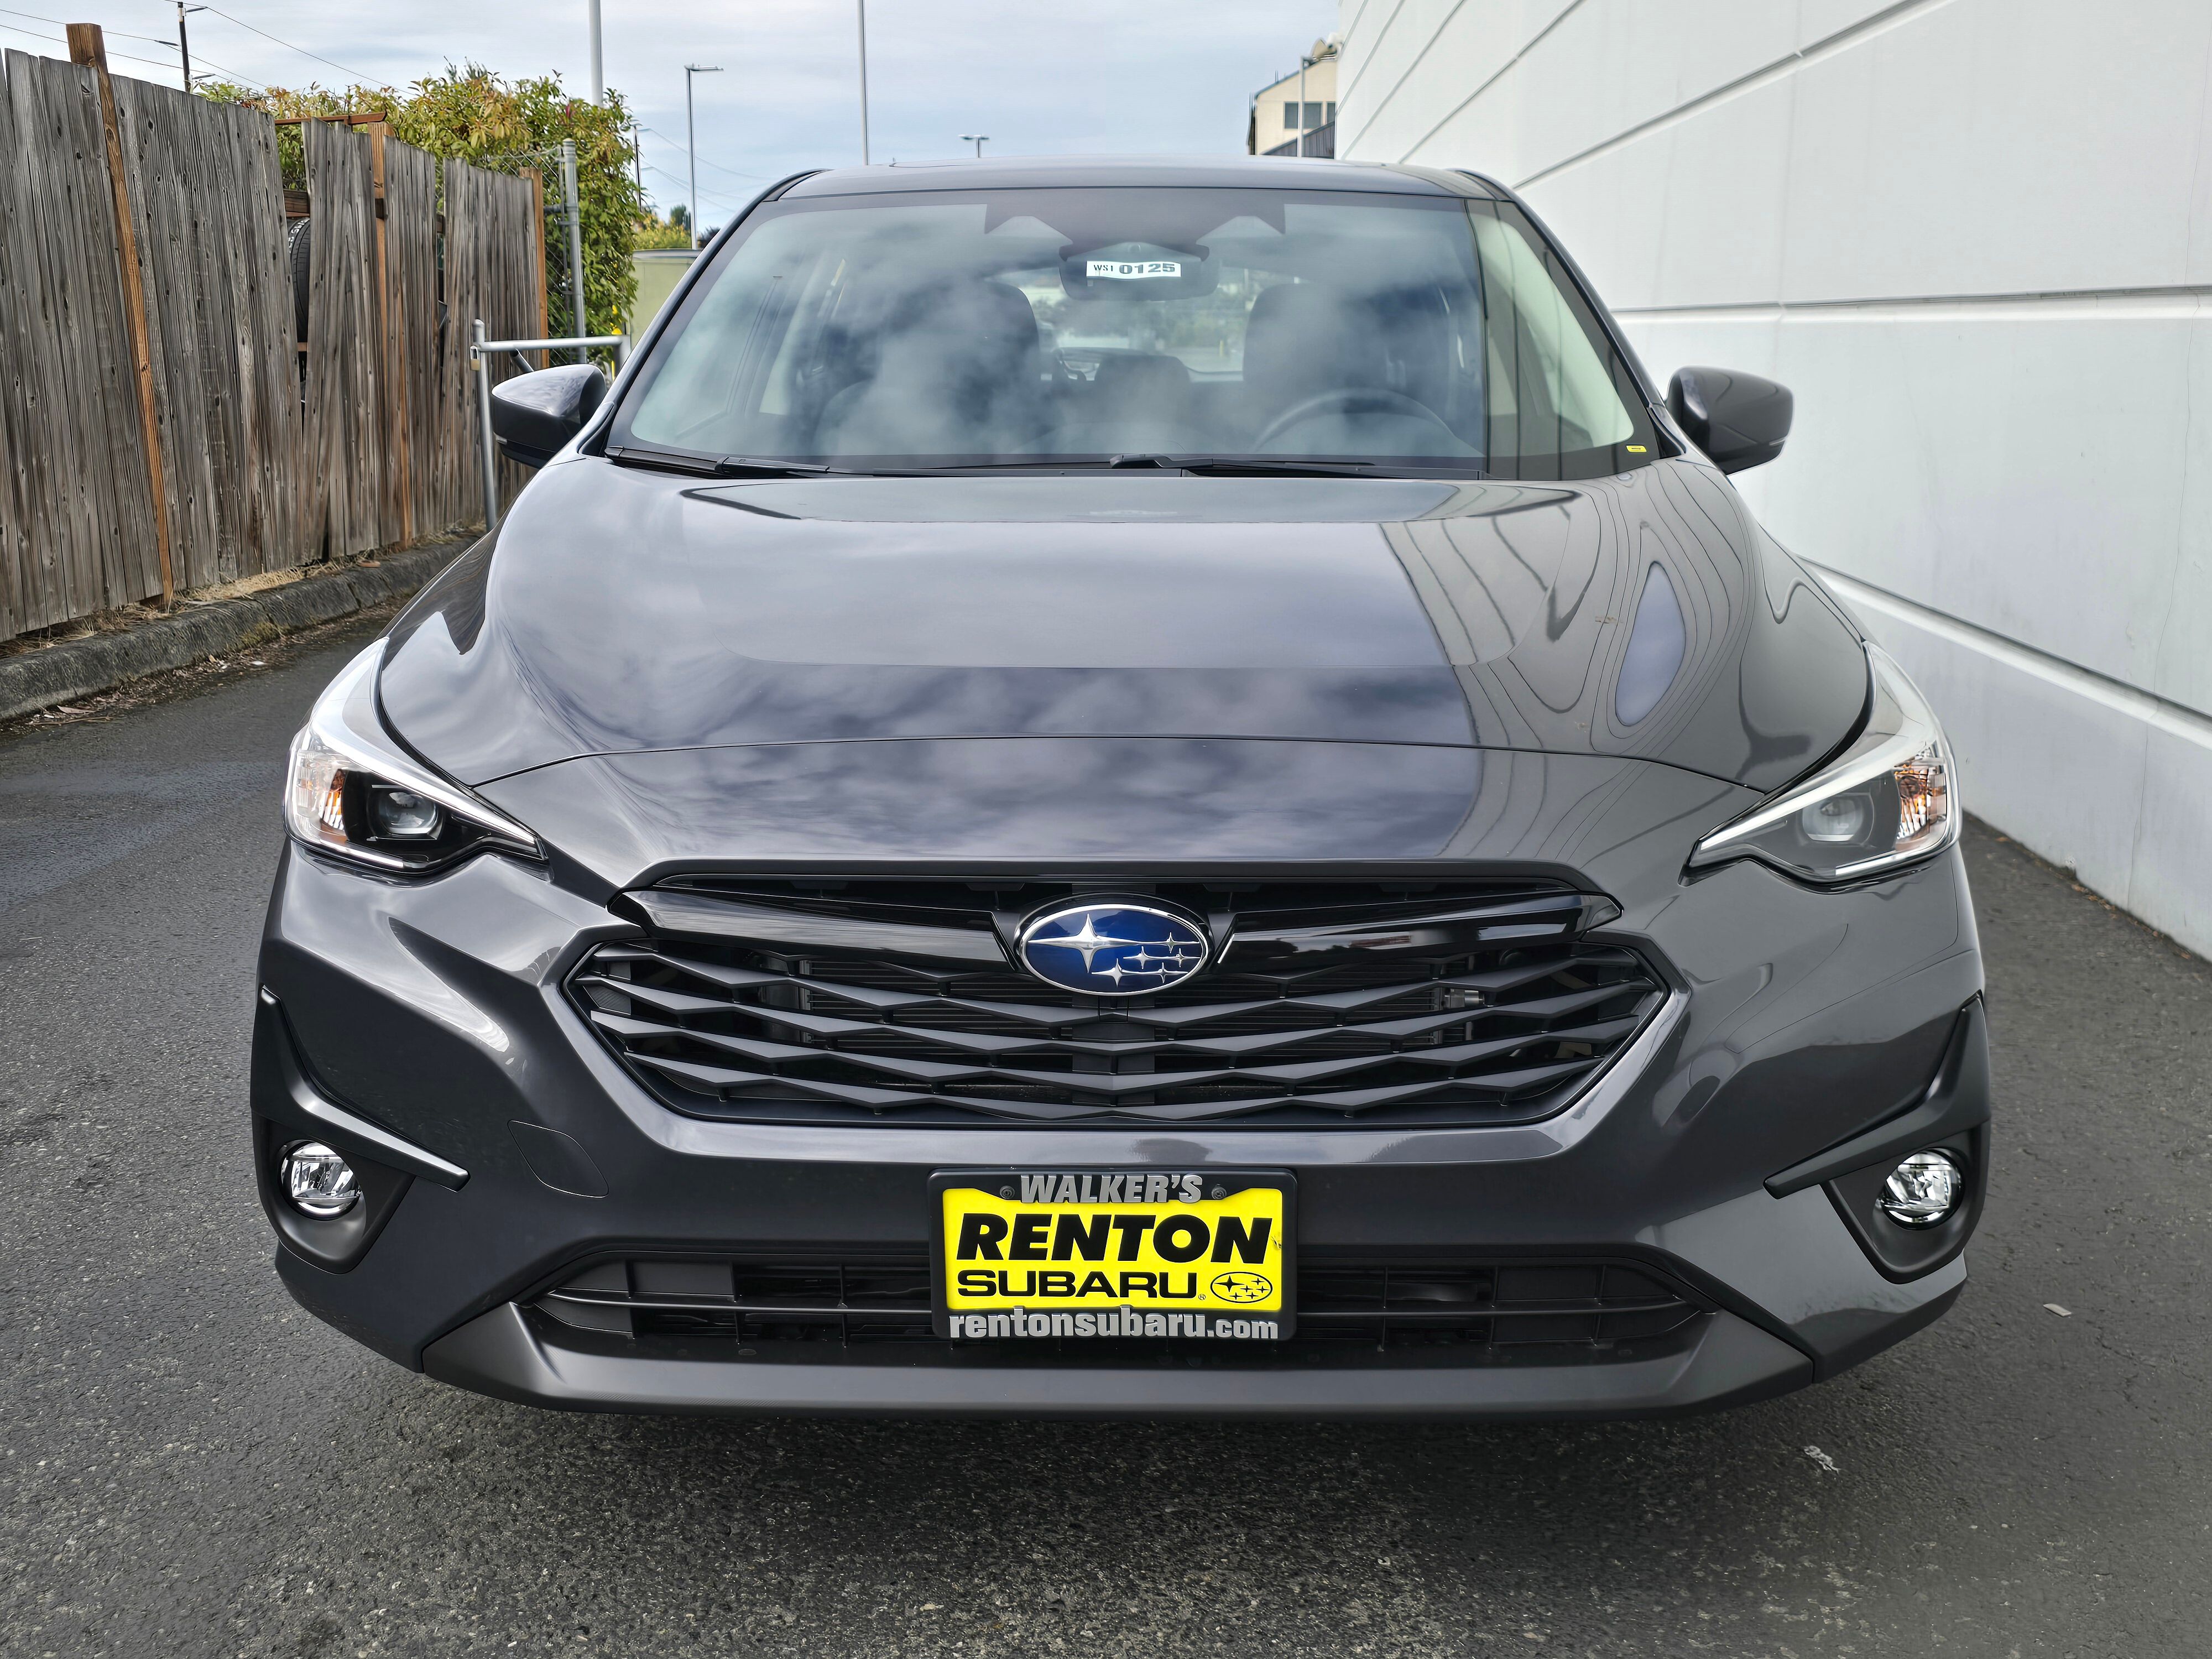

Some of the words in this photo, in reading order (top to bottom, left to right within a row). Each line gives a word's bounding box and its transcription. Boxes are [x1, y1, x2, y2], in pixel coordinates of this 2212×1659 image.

[1119, 263, 1175, 274] 0125
[1021, 1175, 1202, 1203] WALKER'S
[956, 1213, 1272, 1264] RENTON
[957, 1270, 1198, 1298] SUBARU
[950, 1306, 1278, 1340] rentonsubaru.com
